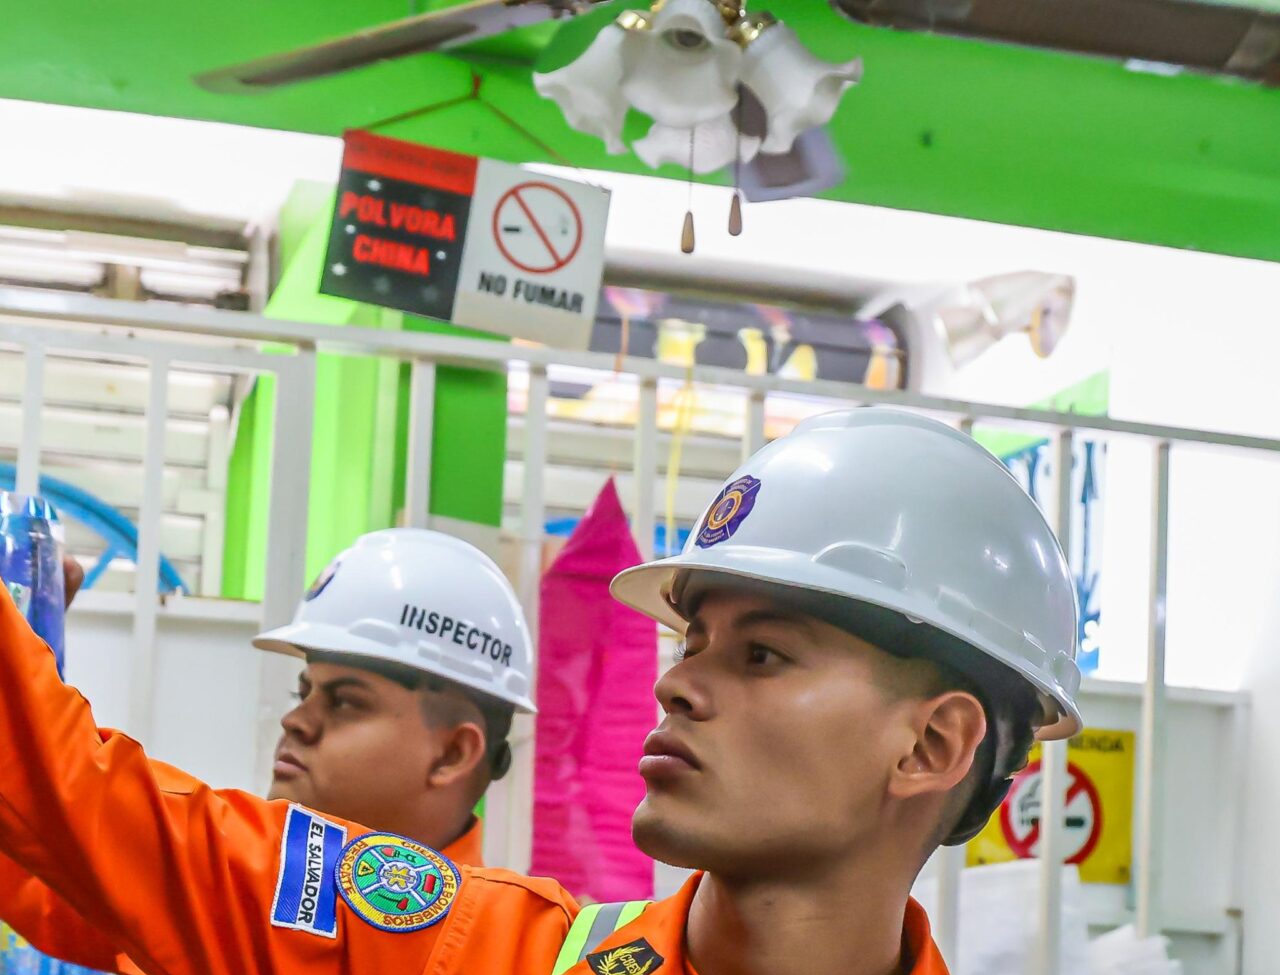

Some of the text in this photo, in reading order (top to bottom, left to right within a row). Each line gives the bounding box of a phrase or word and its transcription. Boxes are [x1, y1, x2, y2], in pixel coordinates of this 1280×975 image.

[339, 191, 456, 241] POLVORA
[352, 234, 430, 276] CHINA
[477, 272, 584, 313] NO FUMAR
[399, 604, 513, 668] INSPECTOR
[298, 821, 324, 925] EL SALVADOR
[338, 839, 370, 897] RESCATE
[400, 840, 451, 872] CUERPO
[383, 891, 454, 927] BOMBEROS
[620, 952, 641, 975] CBES
